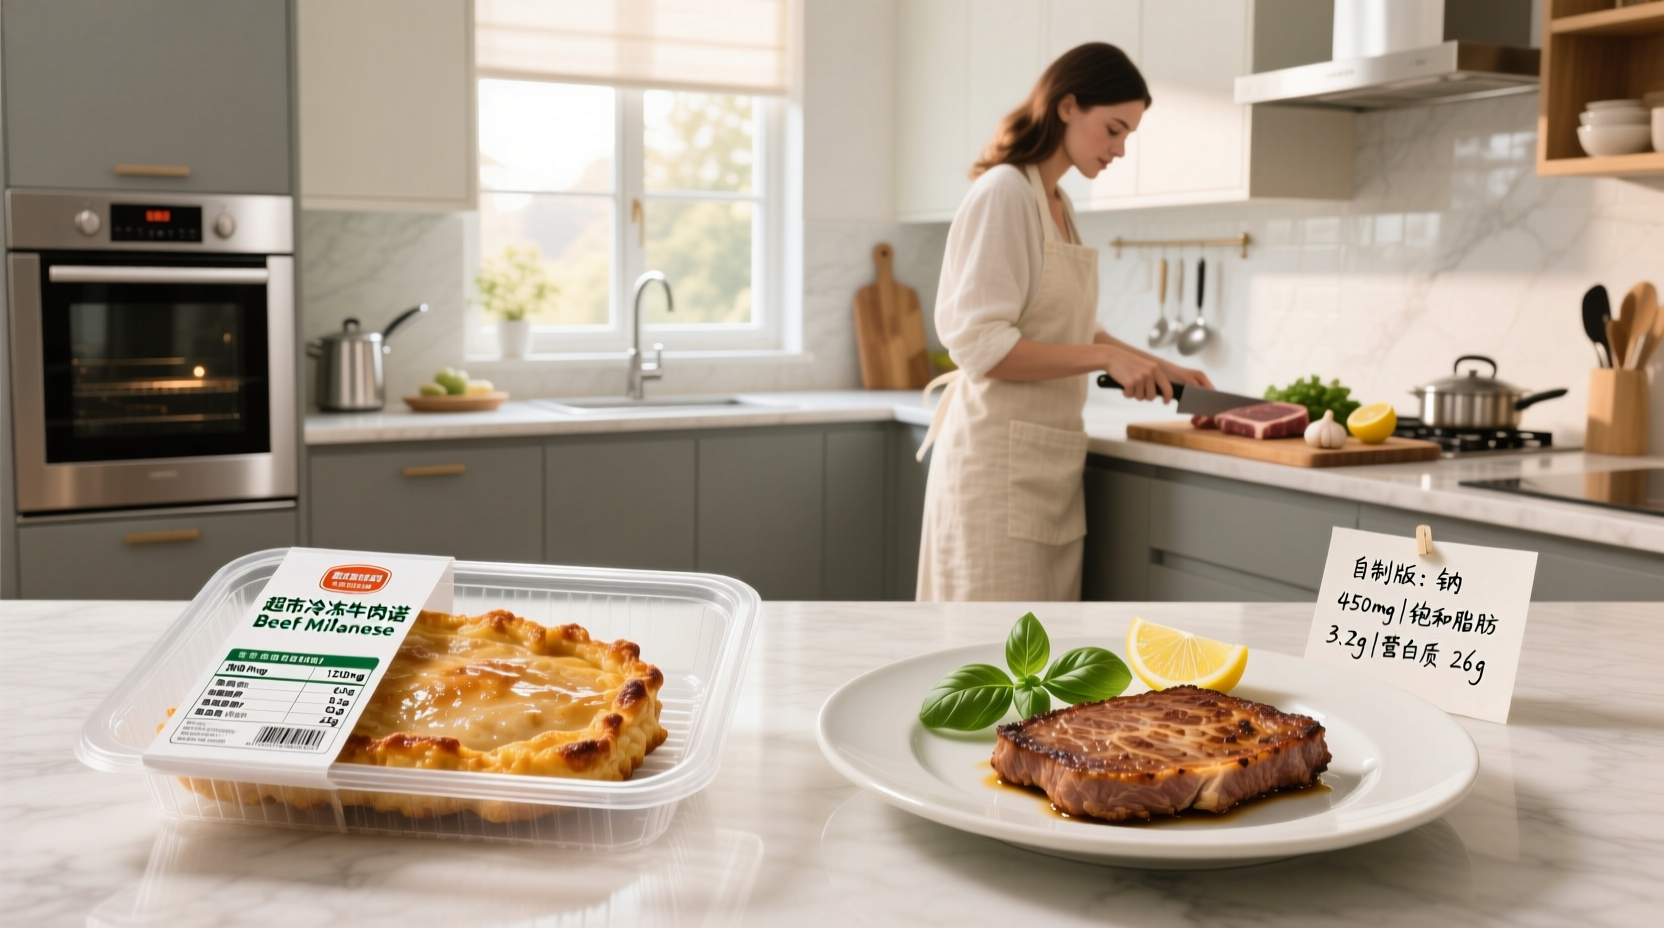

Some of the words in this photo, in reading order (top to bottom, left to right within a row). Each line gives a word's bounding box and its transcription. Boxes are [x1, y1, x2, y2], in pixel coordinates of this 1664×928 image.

[253, 614, 303, 631] Beef
[304, 618, 395, 636] Milanese
[1450, 650, 1486, 686] 26g
